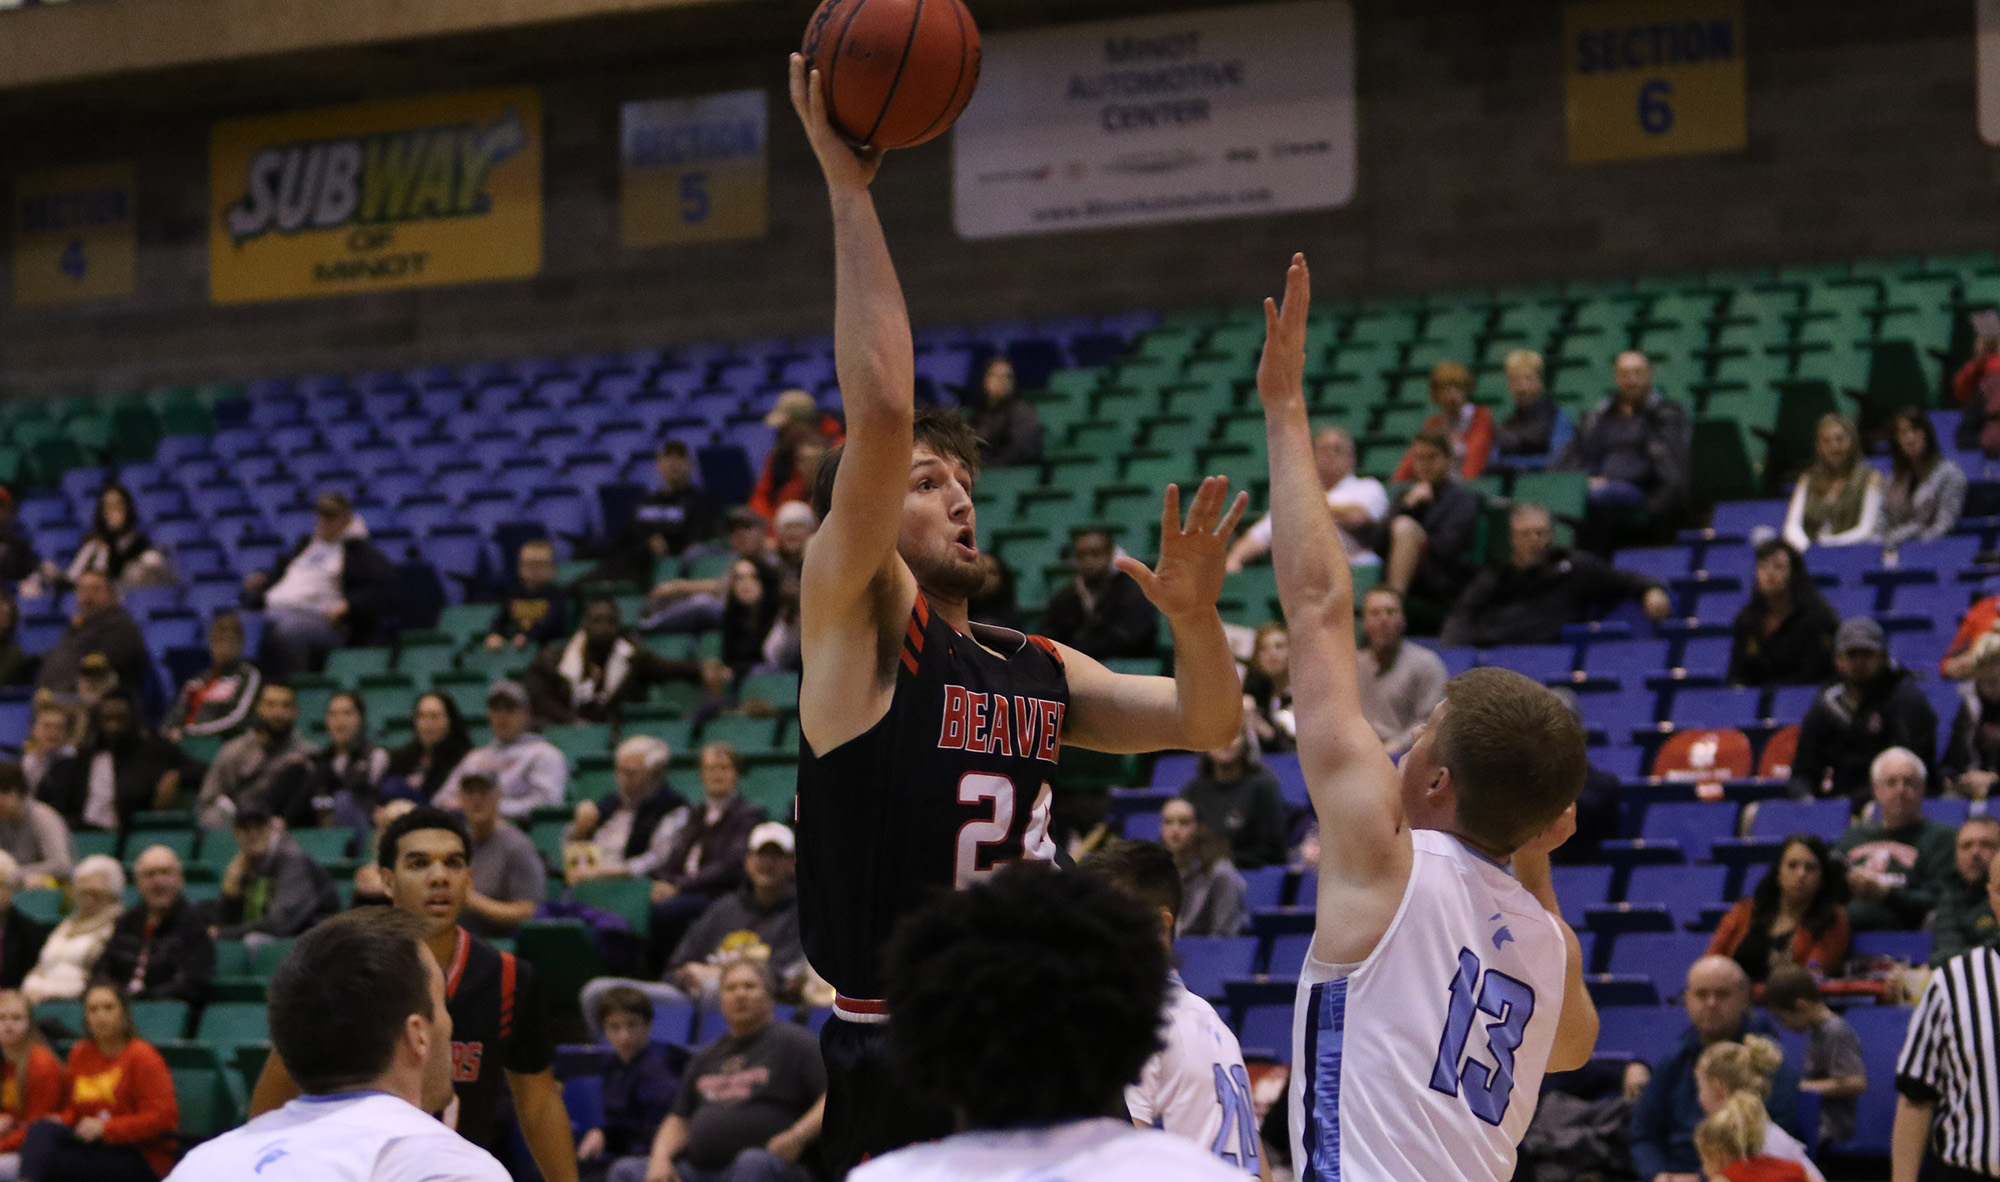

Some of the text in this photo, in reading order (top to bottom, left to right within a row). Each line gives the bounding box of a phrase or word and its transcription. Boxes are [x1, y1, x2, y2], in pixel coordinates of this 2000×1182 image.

[1104, 30, 1202, 64] MINOT
[1577, 20, 1734, 73] SECTION
[1101, 97, 1212, 132] CENTER
[1638, 79, 1675, 135] 6
[224, 108, 527, 248] SUBWAY
[680, 172, 711, 225] 5
[60, 238, 87, 280] 4
[348, 225, 396, 252] OF
[313, 251, 429, 281] MINOT
[1429, 945, 1536, 1127] 13
[1211, 1062, 1262, 1179] 20
